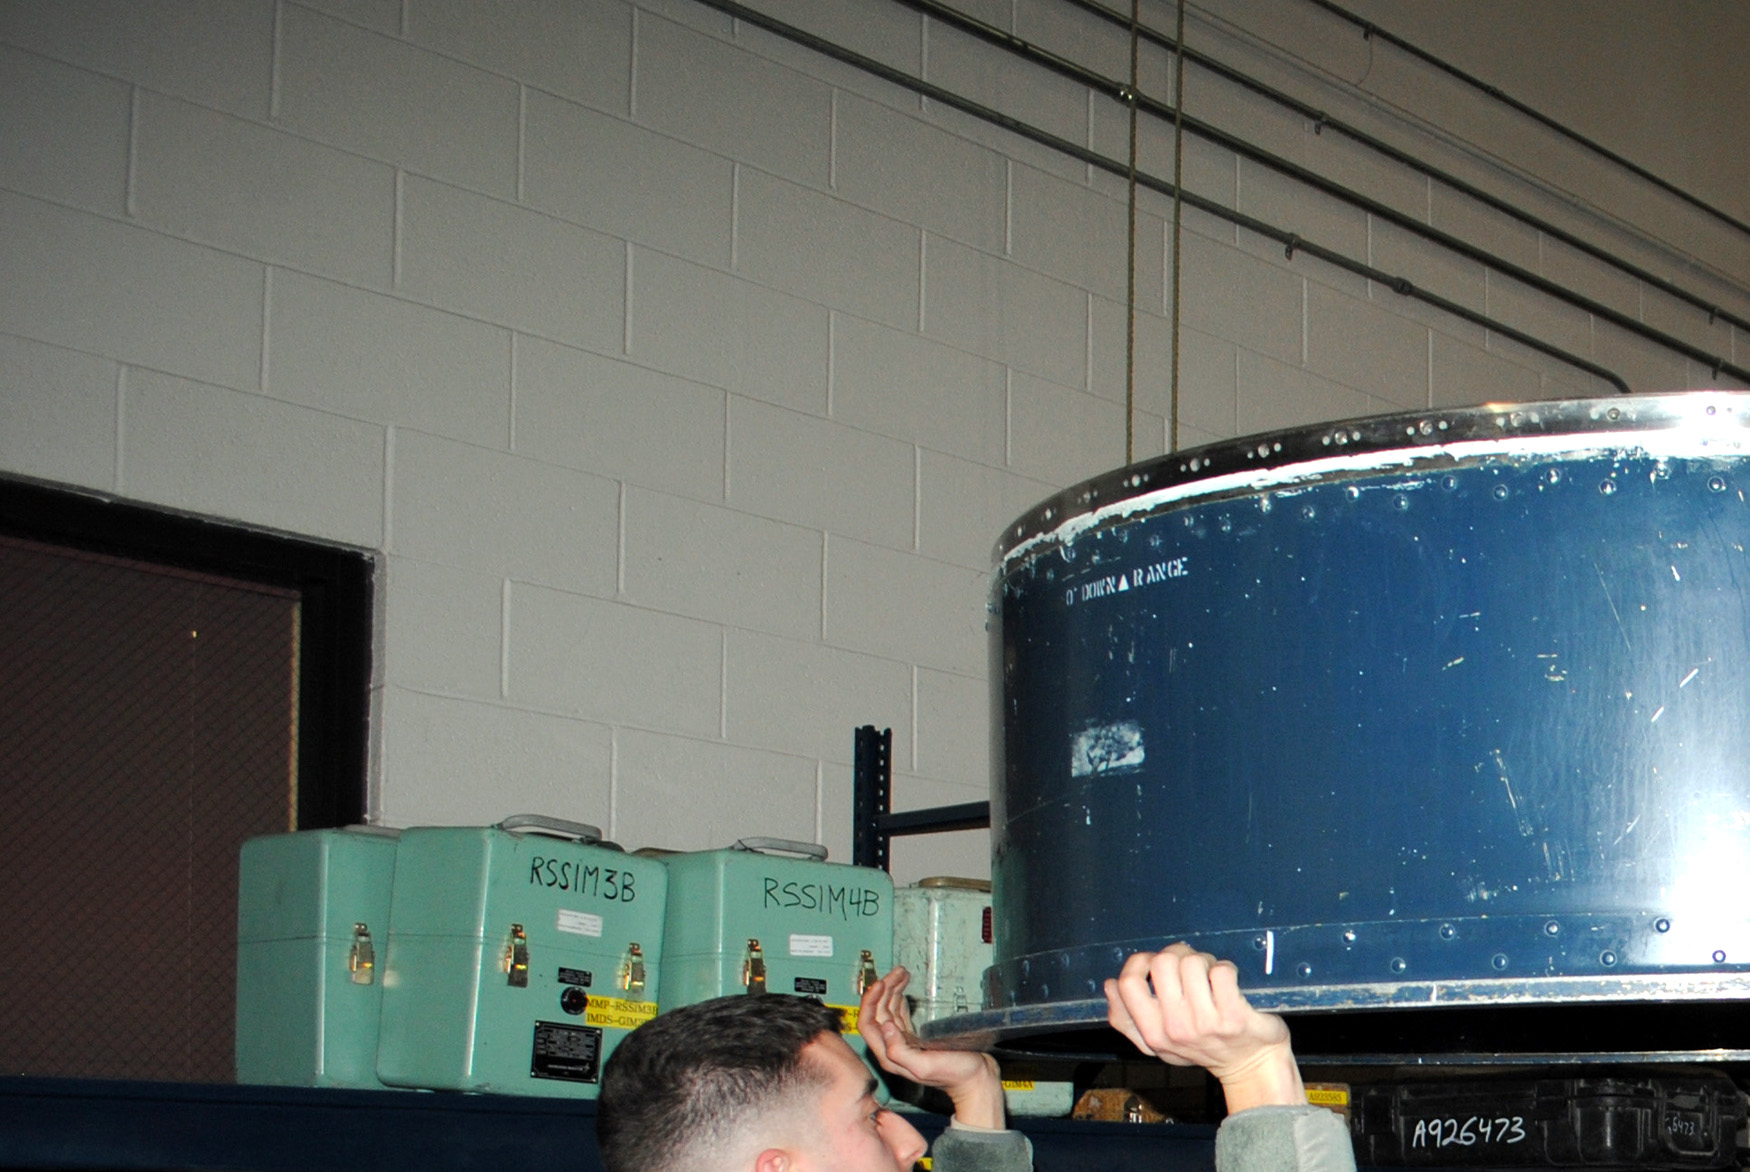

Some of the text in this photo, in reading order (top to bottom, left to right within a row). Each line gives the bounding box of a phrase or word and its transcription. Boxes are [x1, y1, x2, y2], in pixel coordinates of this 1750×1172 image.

[1133, 557, 1188, 587] RANGE
[530, 856, 636, 903] RSSIM3B
[764, 877, 880, 921] RSSIM4B
[1412, 1116, 1526, 1148] A926473
